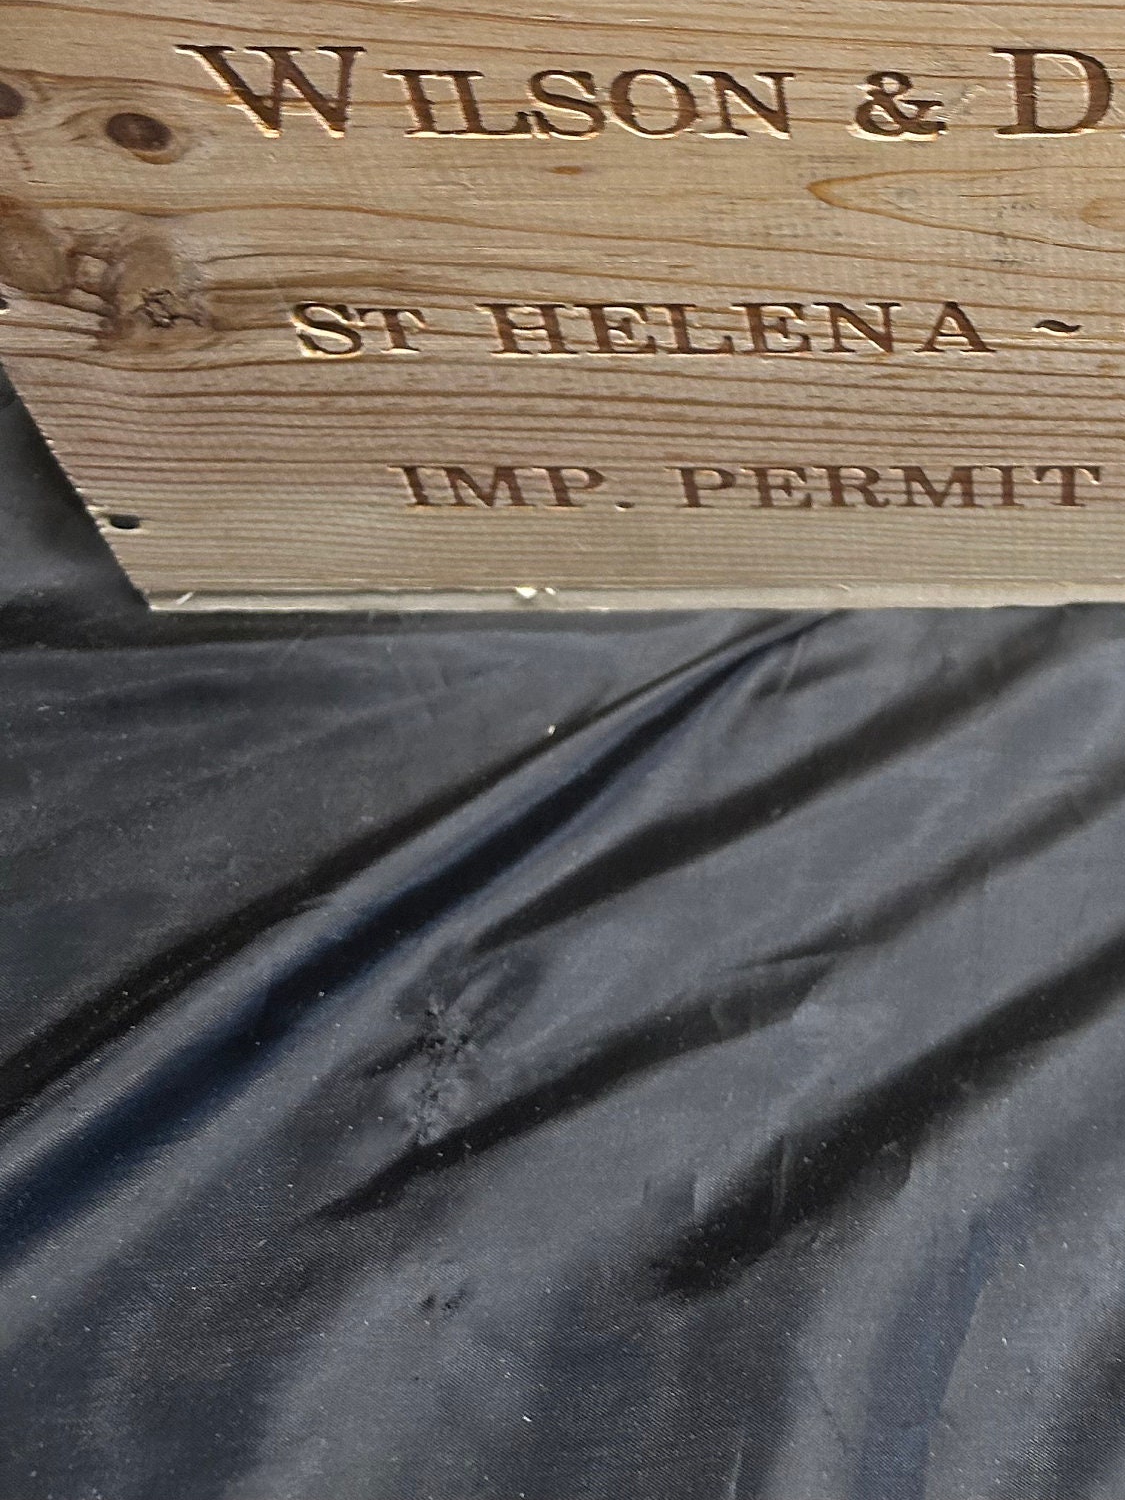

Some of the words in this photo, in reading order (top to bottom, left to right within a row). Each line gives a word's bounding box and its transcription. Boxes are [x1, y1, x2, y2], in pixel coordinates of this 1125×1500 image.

[175, 45, 796, 140] WILSON
[852, 71, 948, 141] &
[290, 301, 426, 360] ST
[477, 300, 998, 357] HELENA
[390, 465, 634, 511] IMP.
[666, 463, 1104, 511] PERMIT
